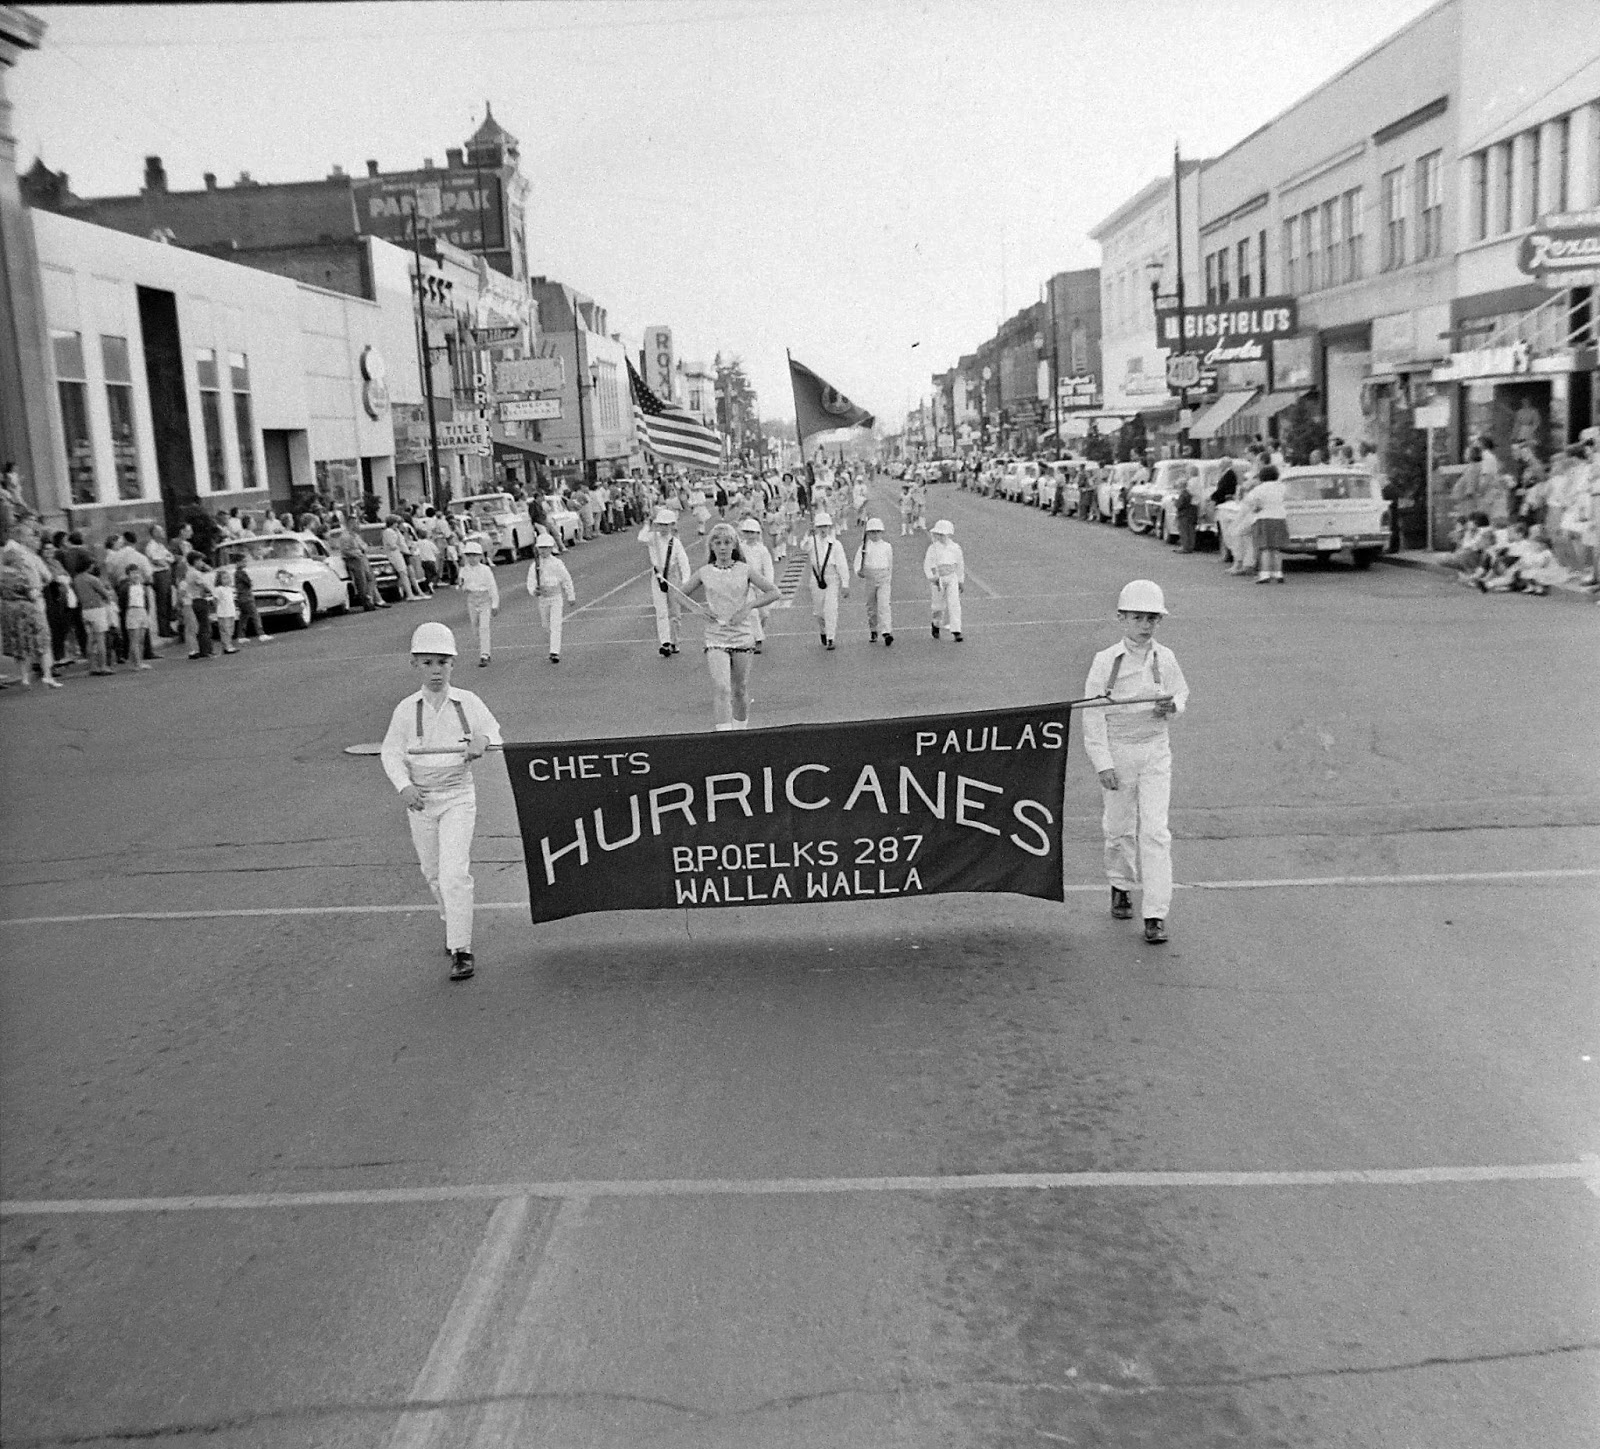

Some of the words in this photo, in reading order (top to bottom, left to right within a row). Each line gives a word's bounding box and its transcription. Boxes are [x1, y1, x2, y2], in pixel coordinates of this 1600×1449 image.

[445, 424, 479, 435] TITLE
[917, 722, 1064, 755] PAULA'S
[528, 752, 651, 781] CHET'S
[540, 763, 1054, 885] HURRICANES
[853, 835, 923, 864] 287
[674, 873, 792, 905] WALLA
[806, 867, 923, 899] WALLA
